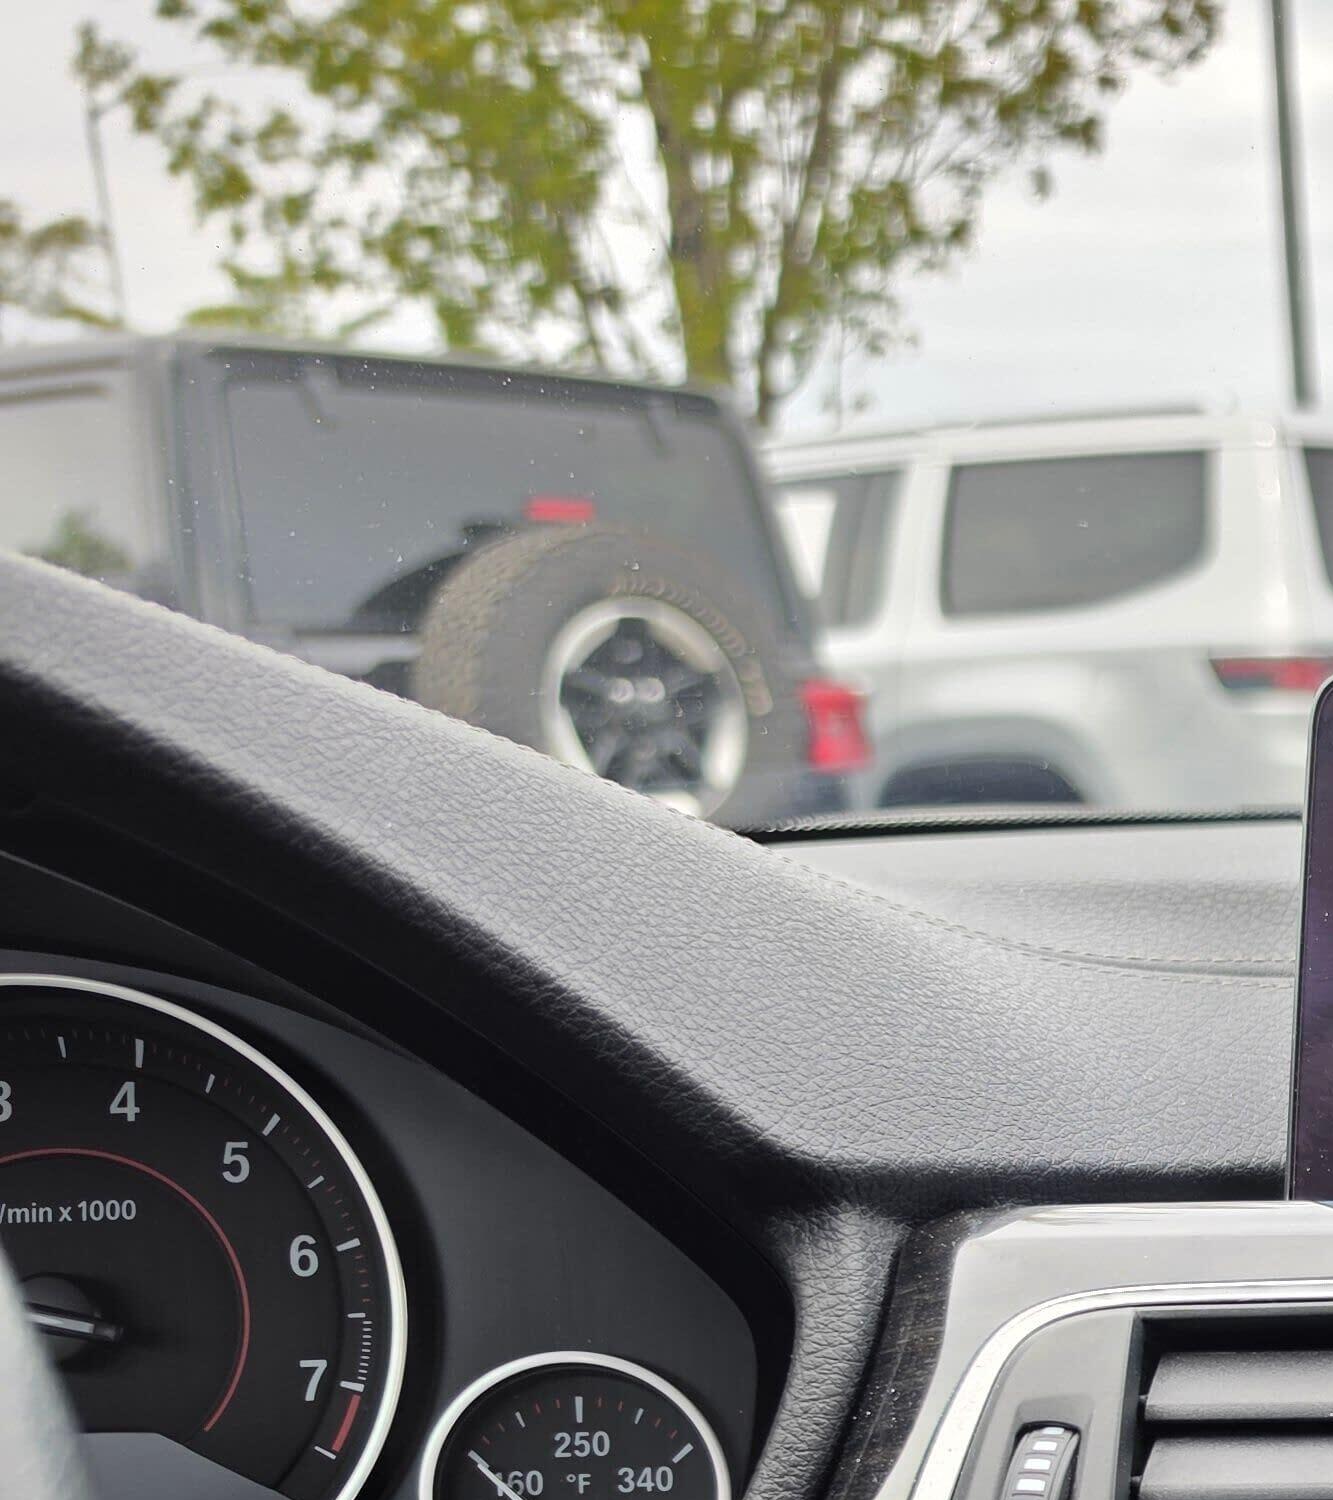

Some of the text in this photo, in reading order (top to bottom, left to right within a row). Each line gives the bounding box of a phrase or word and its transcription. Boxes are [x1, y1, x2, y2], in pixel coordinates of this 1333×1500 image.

[108, 1081, 141, 1122] 4
[221, 1141, 250, 1184] 5
[58, 1205, 73, 1222] x
[77, 1199, 137, 1222] 1000
[288, 1235, 320, 1278] 6
[298, 1358, 330, 1402] 7
[553, 1430, 611, 1458] 250
[617, 1465, 674, 1493] 340
